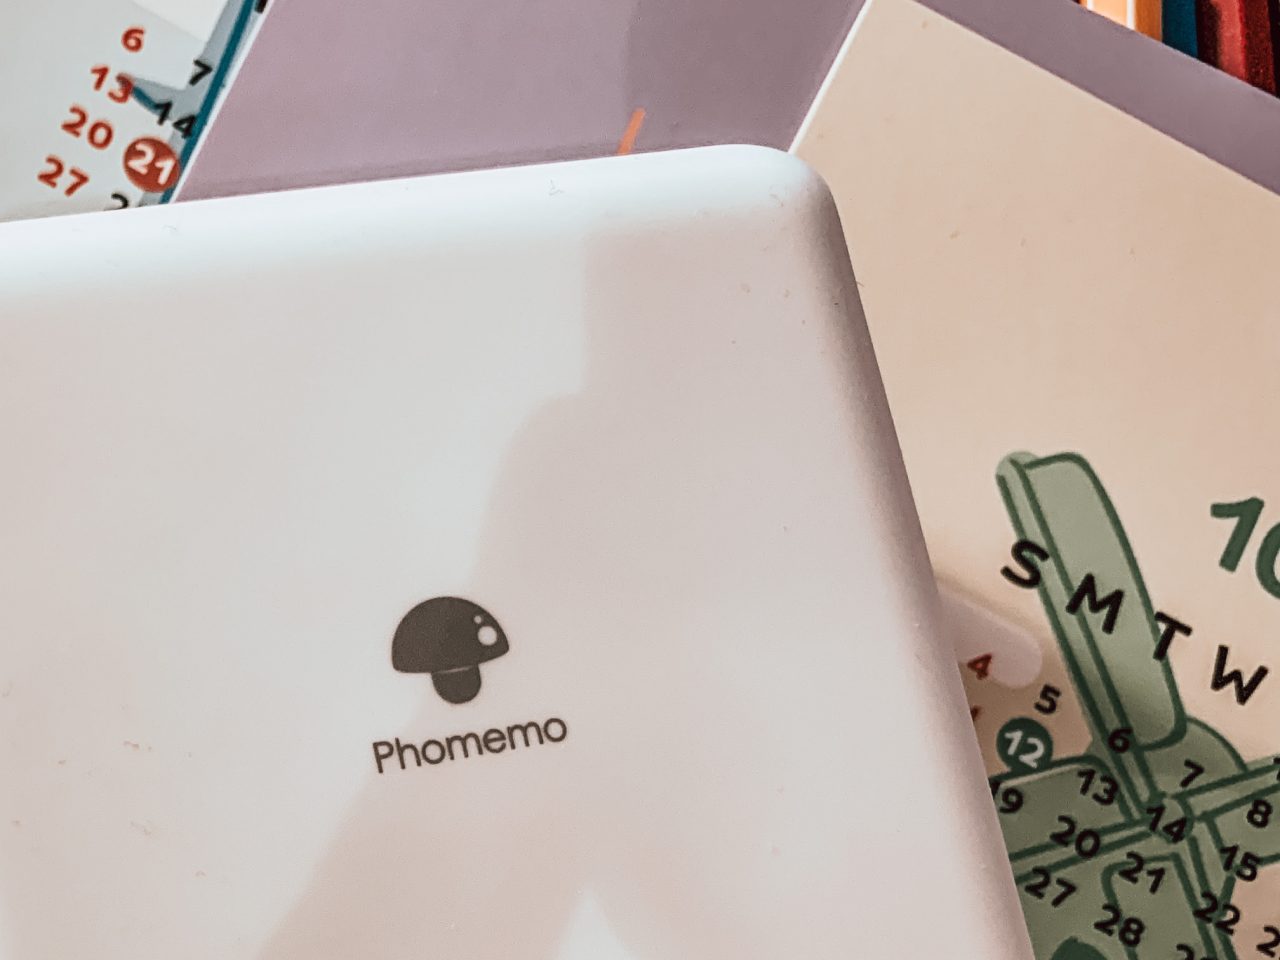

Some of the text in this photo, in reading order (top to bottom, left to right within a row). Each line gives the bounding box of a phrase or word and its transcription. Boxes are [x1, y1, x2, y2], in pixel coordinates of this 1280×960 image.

[121, 27, 213, 86] 6 7
[90, 65, 197, 139] 13 14
[37, 155, 90, 196] 27
[61, 106, 176, 186] 20 21
[1000, 539, 1268, 705] S M T W
[372, 718, 568, 774] Phomemo
[967, 653, 1273, 828] 4 5 6 7 8
[1004, 730, 1261, 882] 12 13 14 15
[1024, 866, 1076, 907] 27
[1094, 903, 1145, 947] 28
[1050, 815, 1100, 858] 20
[1118, 851, 1165, 894] 21
[1193, 891, 1240, 936] 22
